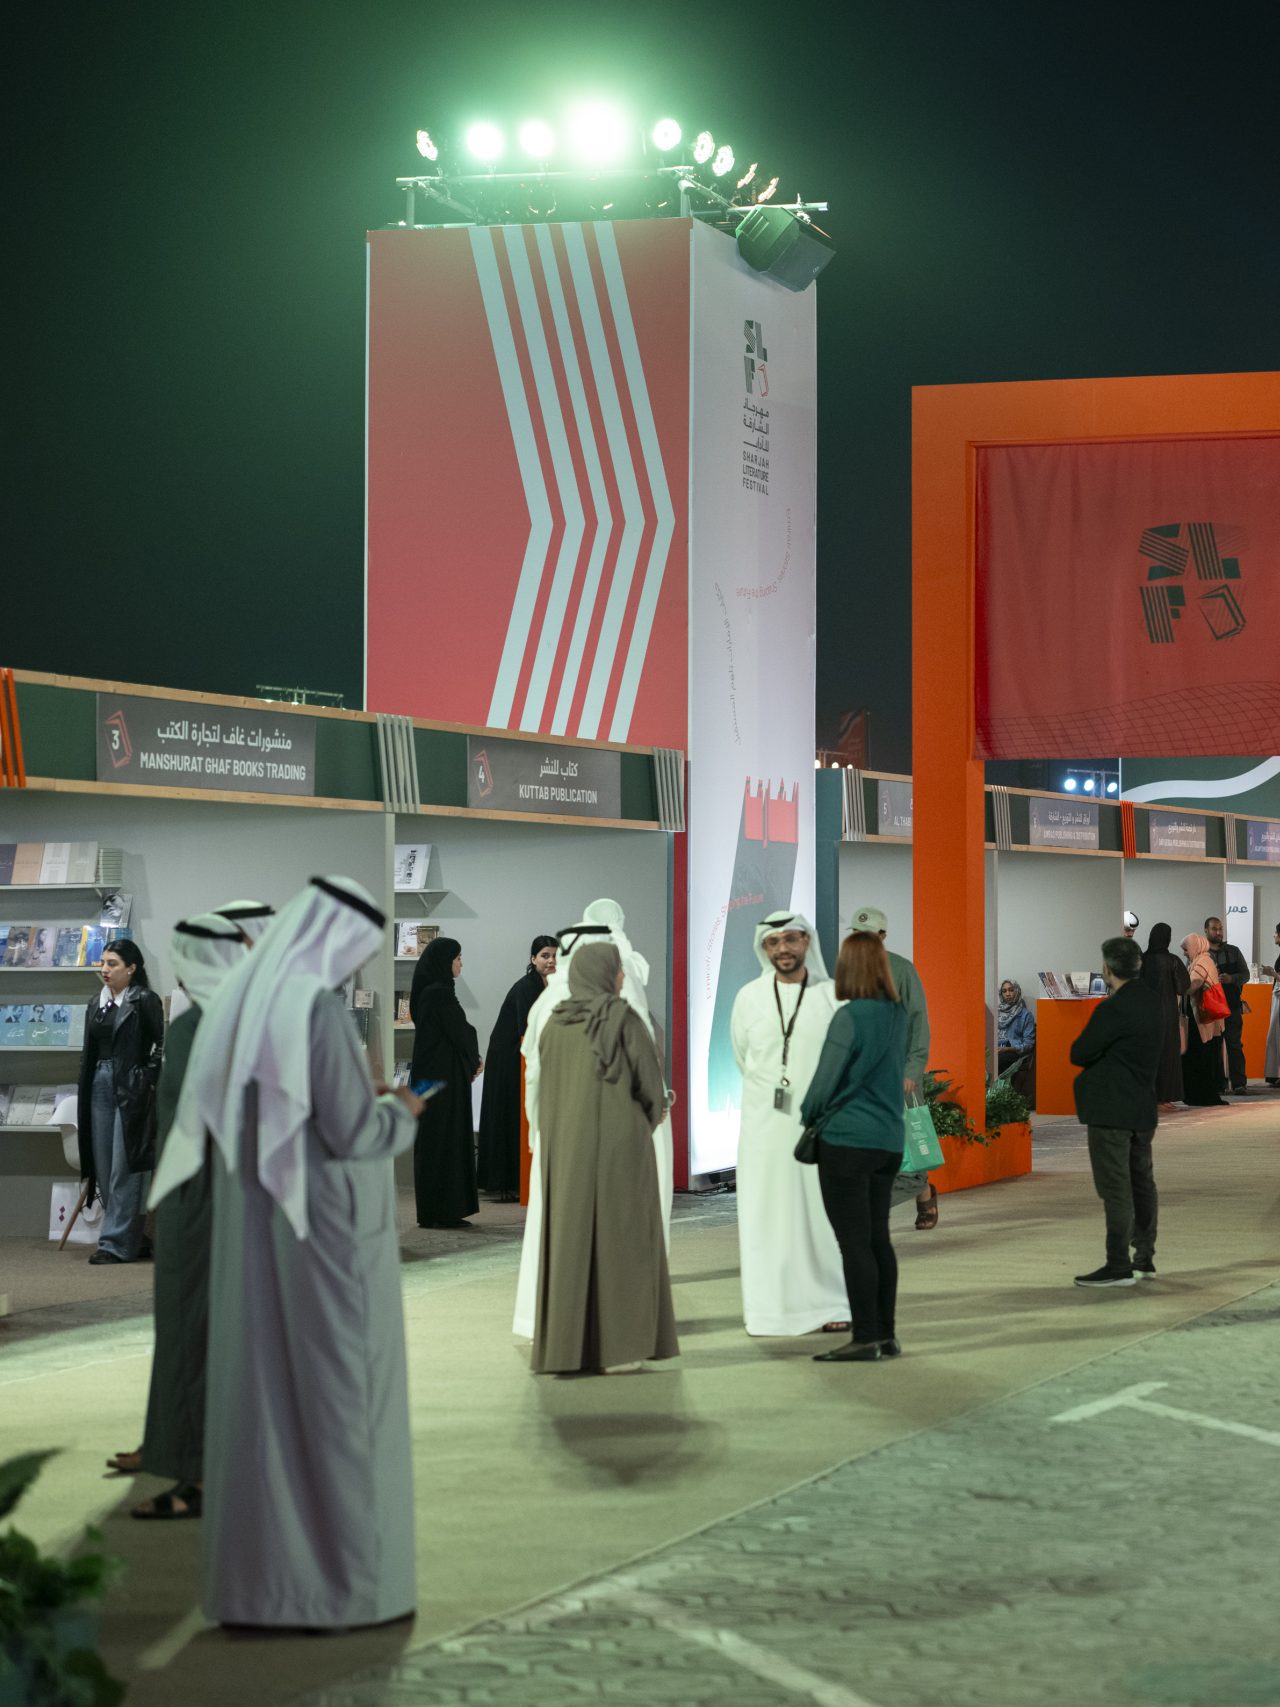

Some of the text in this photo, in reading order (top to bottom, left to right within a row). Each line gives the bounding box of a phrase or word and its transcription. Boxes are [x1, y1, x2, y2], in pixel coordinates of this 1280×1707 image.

[743, 451, 769, 468] SHARJAH
[743, 464, 769, 482] LITERATURE
[743, 477, 769, 495] FESTIVAL
[111, 730, 120, 750] 3
[157, 720, 292, 753] منشورات غاف لتجارة الكتب
[140, 752, 306, 781] MANSHURAT GHAF BOOKS TRADING
[478, 766, 485, 784] 4
[539, 757, 579, 781] كتاب للنشر
[519, 784, 598, 805] KUTTAB PUBLICATION
